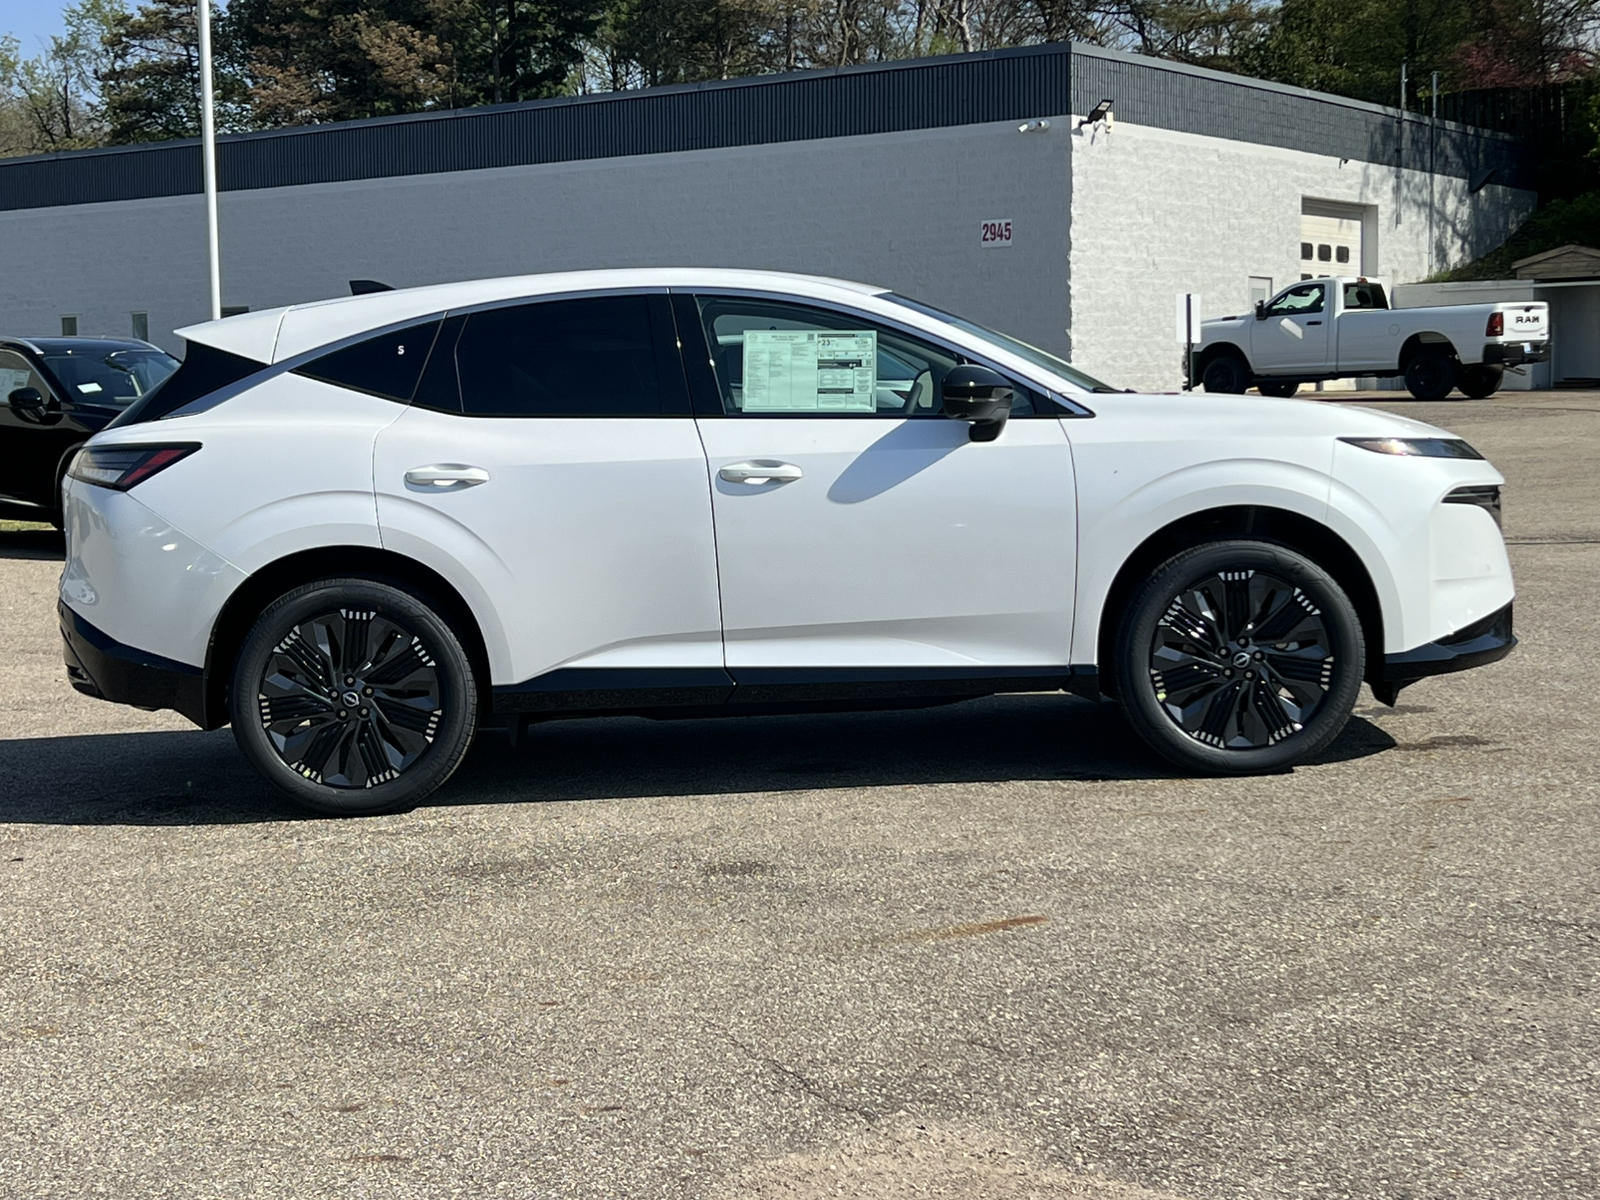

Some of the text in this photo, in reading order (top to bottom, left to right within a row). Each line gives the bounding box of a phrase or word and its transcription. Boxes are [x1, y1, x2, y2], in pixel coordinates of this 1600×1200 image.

[982, 222, 1012, 242] 2945
[1515, 316, 1540, 324] RAM
[397, 345, 405, 355] S
